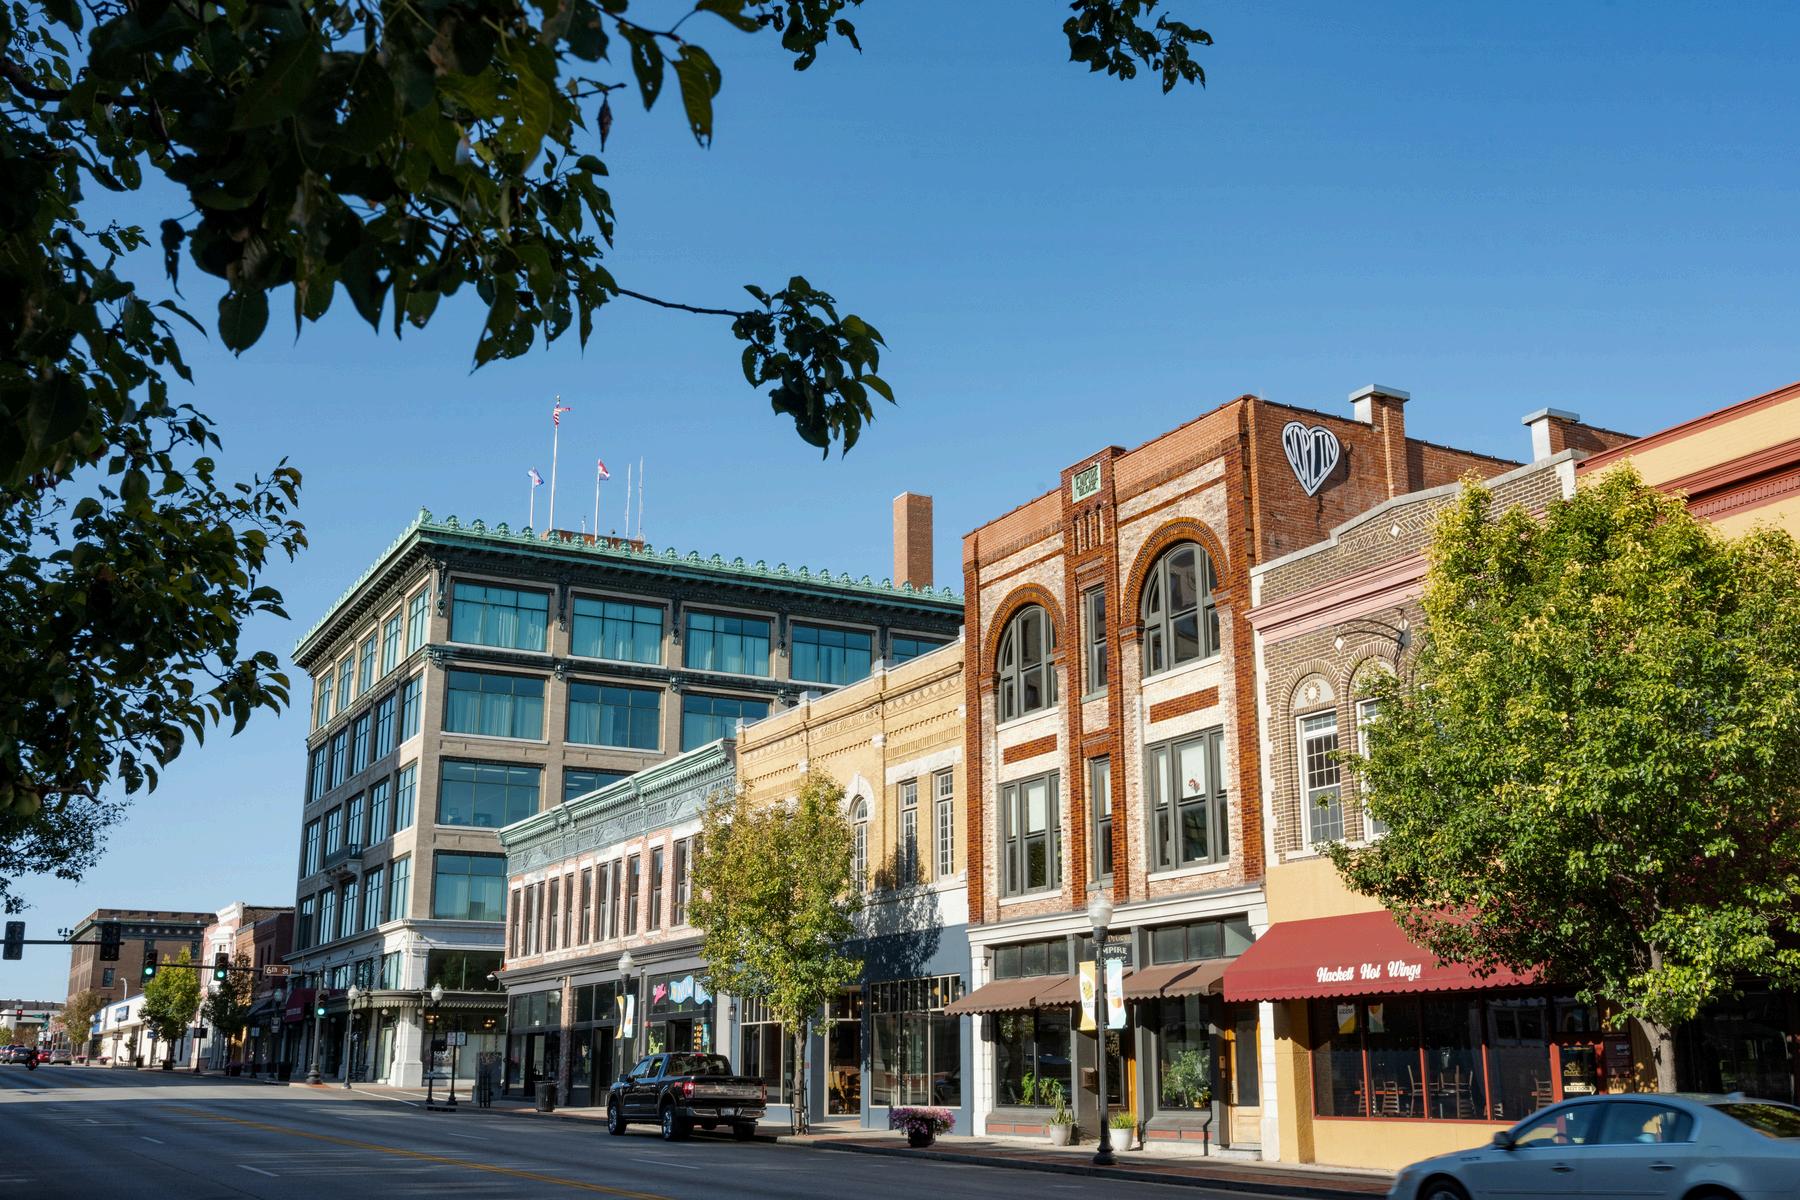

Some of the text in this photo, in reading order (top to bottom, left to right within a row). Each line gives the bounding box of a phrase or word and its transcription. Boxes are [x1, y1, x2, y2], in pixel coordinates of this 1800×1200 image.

[1286, 426, 1336, 488] JOPLIN
[1316, 960, 1422, 982] Hackett Hot Wings
